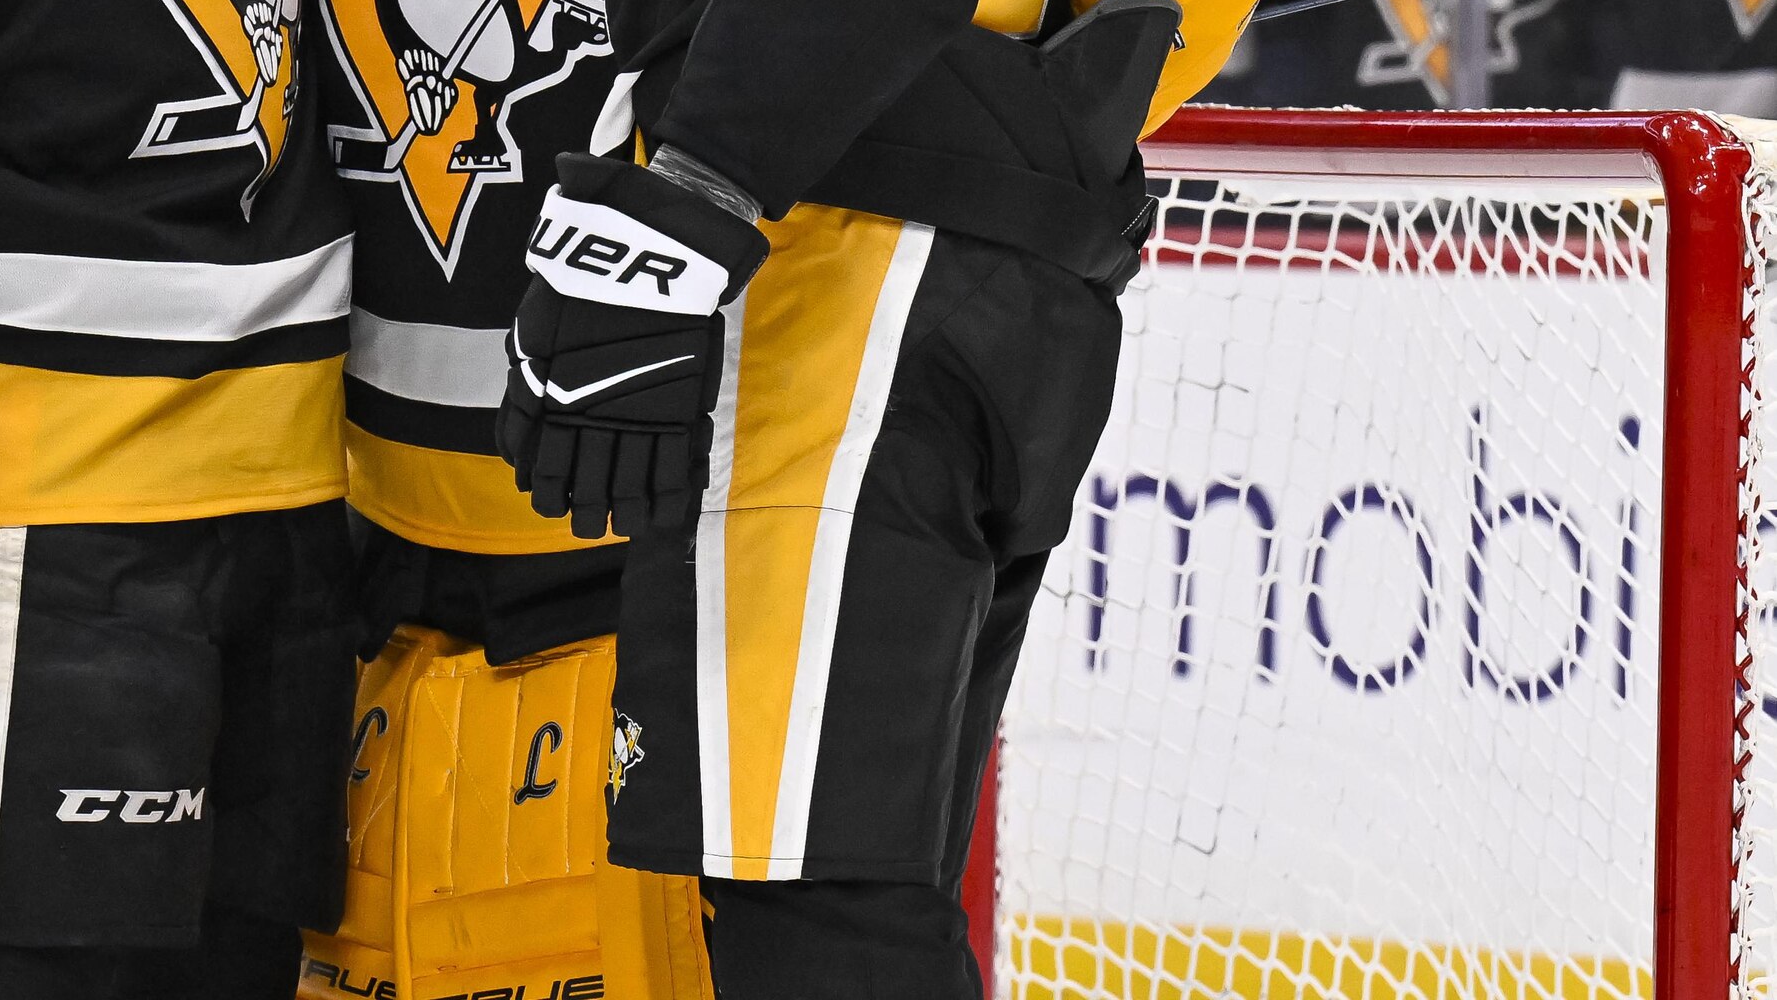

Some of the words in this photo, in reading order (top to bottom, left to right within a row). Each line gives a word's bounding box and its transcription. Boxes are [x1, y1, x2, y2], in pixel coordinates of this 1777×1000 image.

[526, 214, 688, 298] UER
[55, 787, 206, 824] CCM
[428, 974, 605, 1000] RUE
